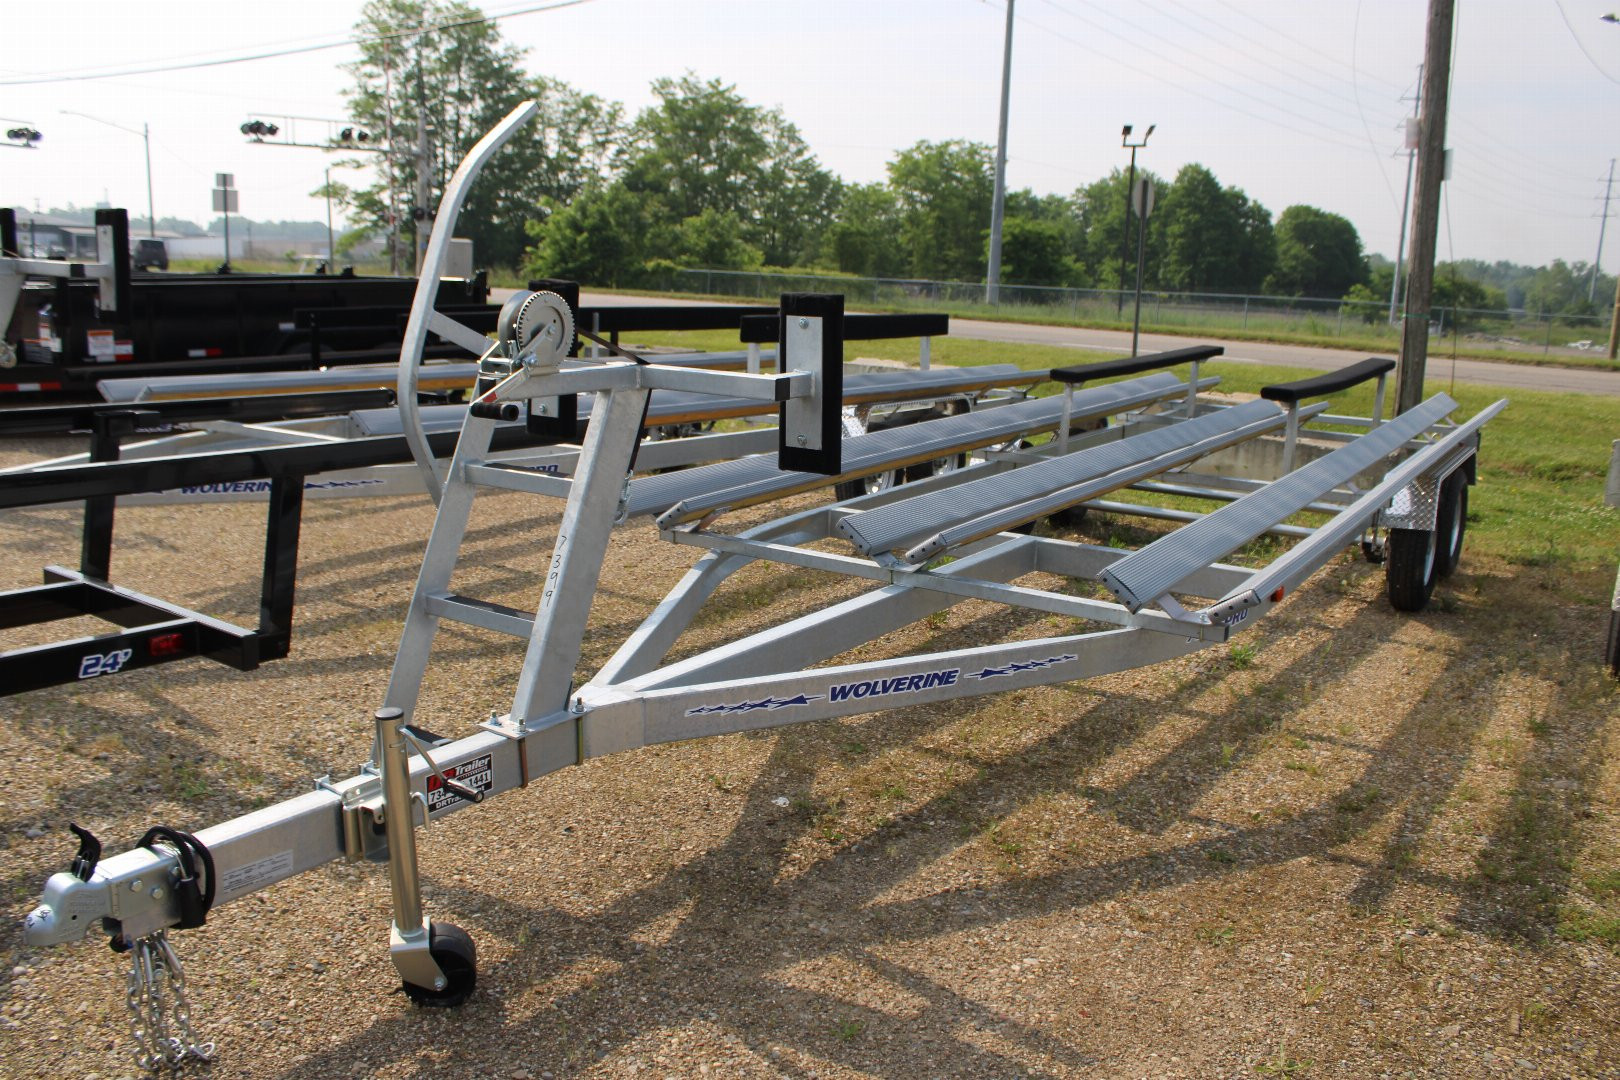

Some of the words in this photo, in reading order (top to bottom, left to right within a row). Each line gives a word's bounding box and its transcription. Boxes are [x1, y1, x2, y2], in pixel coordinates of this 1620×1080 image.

[181, 481, 272, 494] WOLVERIN
[545, 535, 567, 608] 7399
[829, 668, 960, 702] WOLVERINE
[455, 757, 490, 776] Trailer
